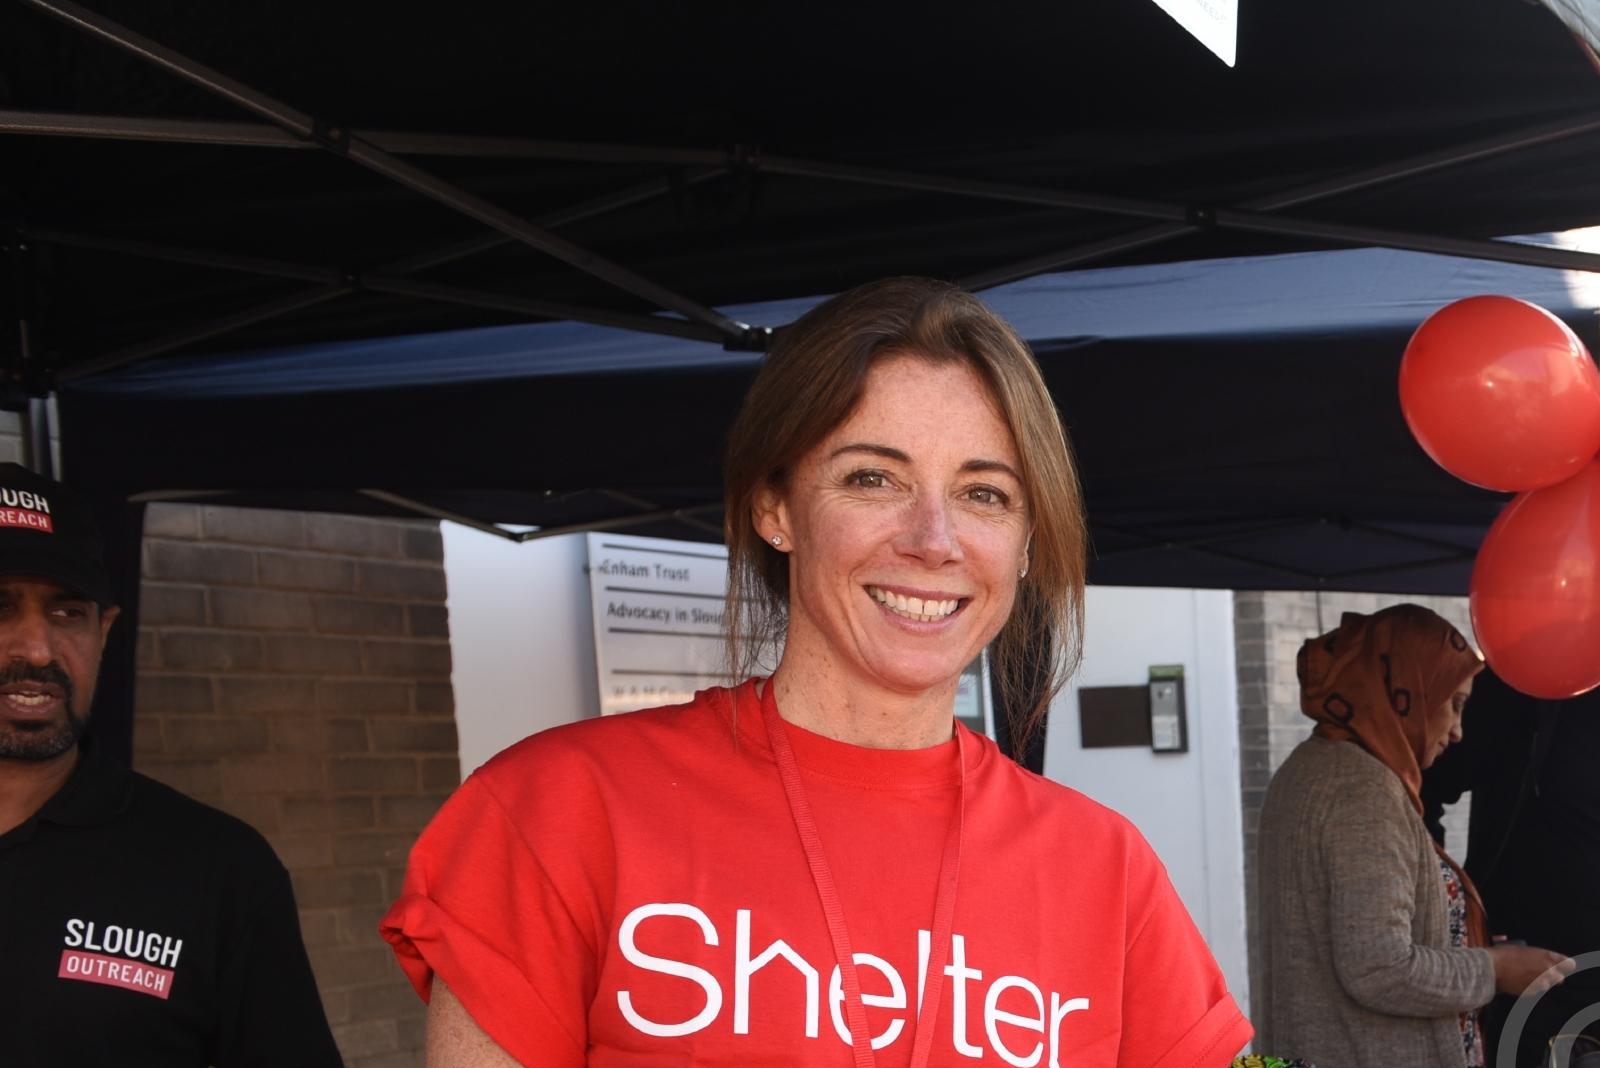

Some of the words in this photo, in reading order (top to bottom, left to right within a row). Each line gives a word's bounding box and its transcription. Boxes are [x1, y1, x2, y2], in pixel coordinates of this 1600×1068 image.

[0, 487, 50, 514] UGH
[653, 564, 690, 582] Trust
[607, 602, 670, 623] Advocacy
[675, 606, 687, 621] in
[64, 918, 183, 968] SLOUGH
[66, 955, 166, 992] OUTREACH
